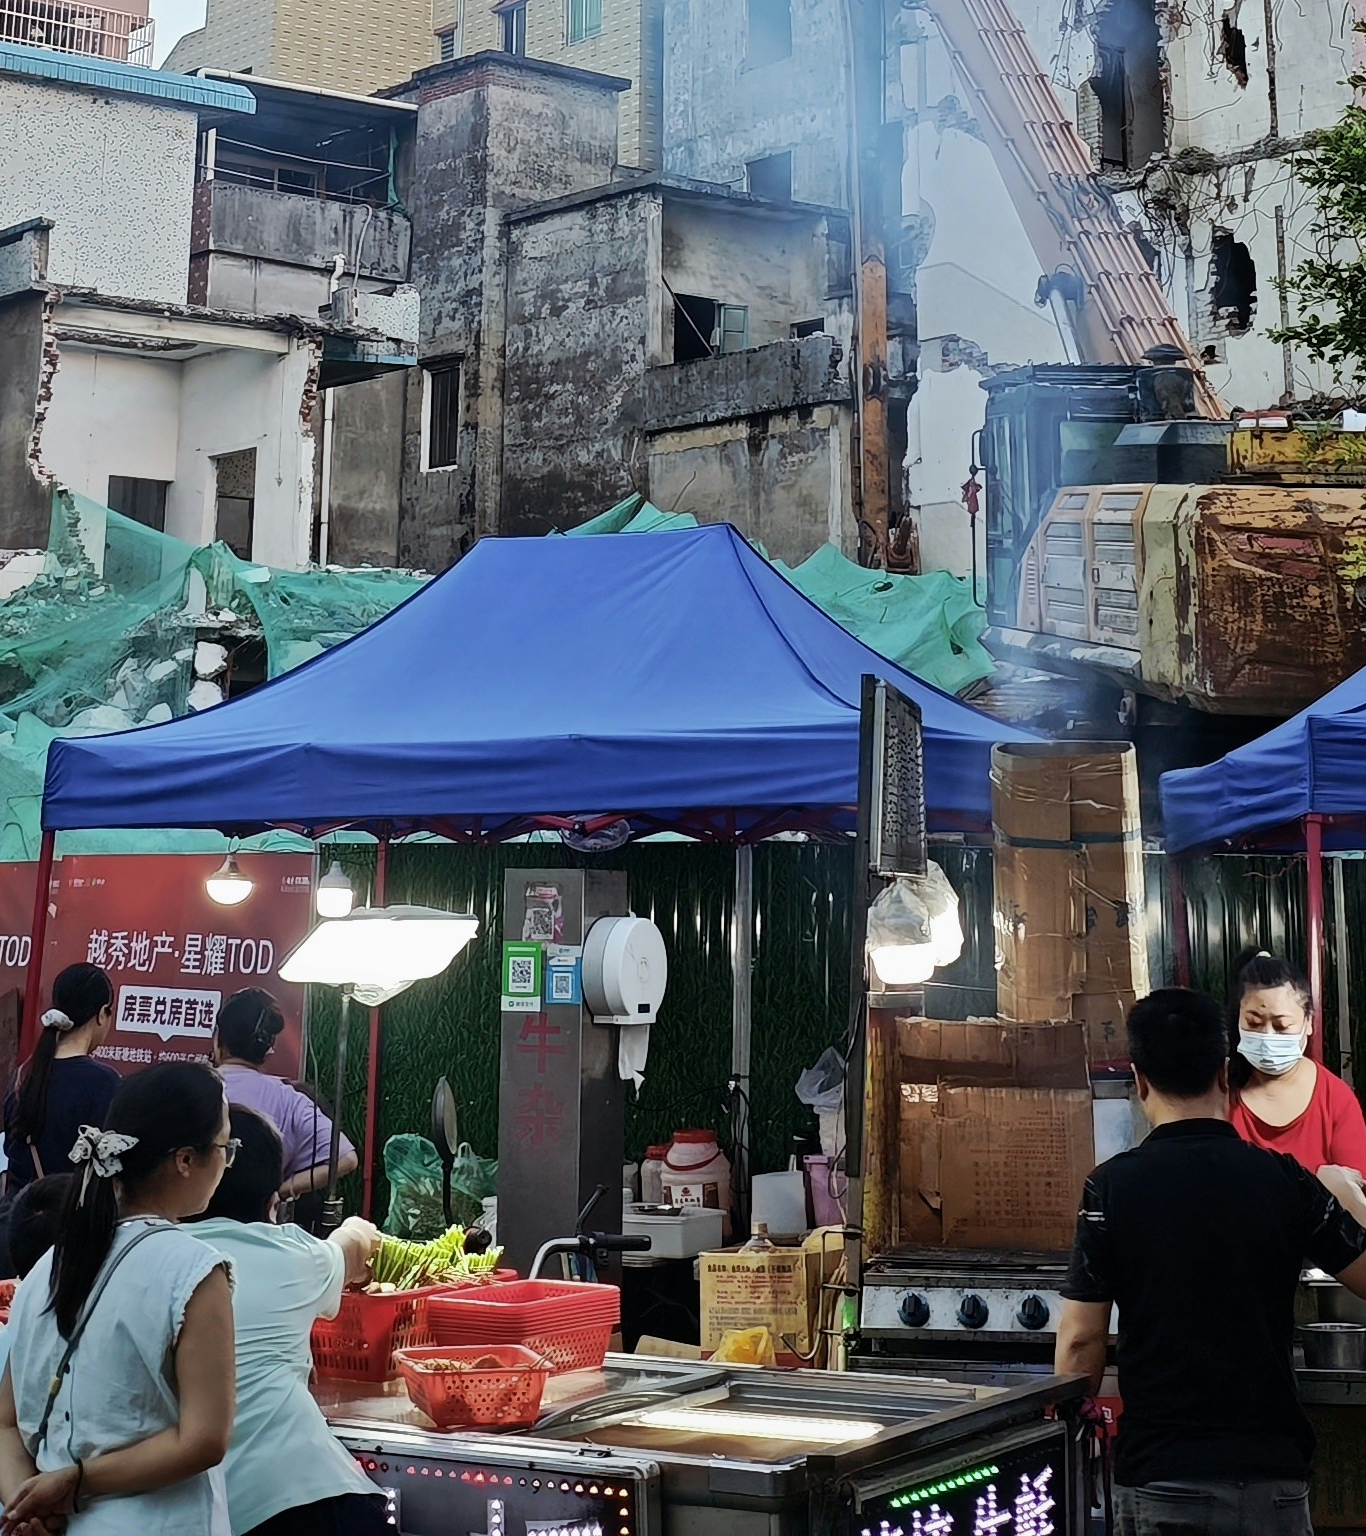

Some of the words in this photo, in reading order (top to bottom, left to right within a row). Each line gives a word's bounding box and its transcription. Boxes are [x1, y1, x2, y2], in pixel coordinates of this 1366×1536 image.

[87, 928, 275, 976] 越秀地产·星耀TOD
[121, 994, 215, 1029] 房票兑房首选
[515, 1012, 569, 1148] 牛杂
